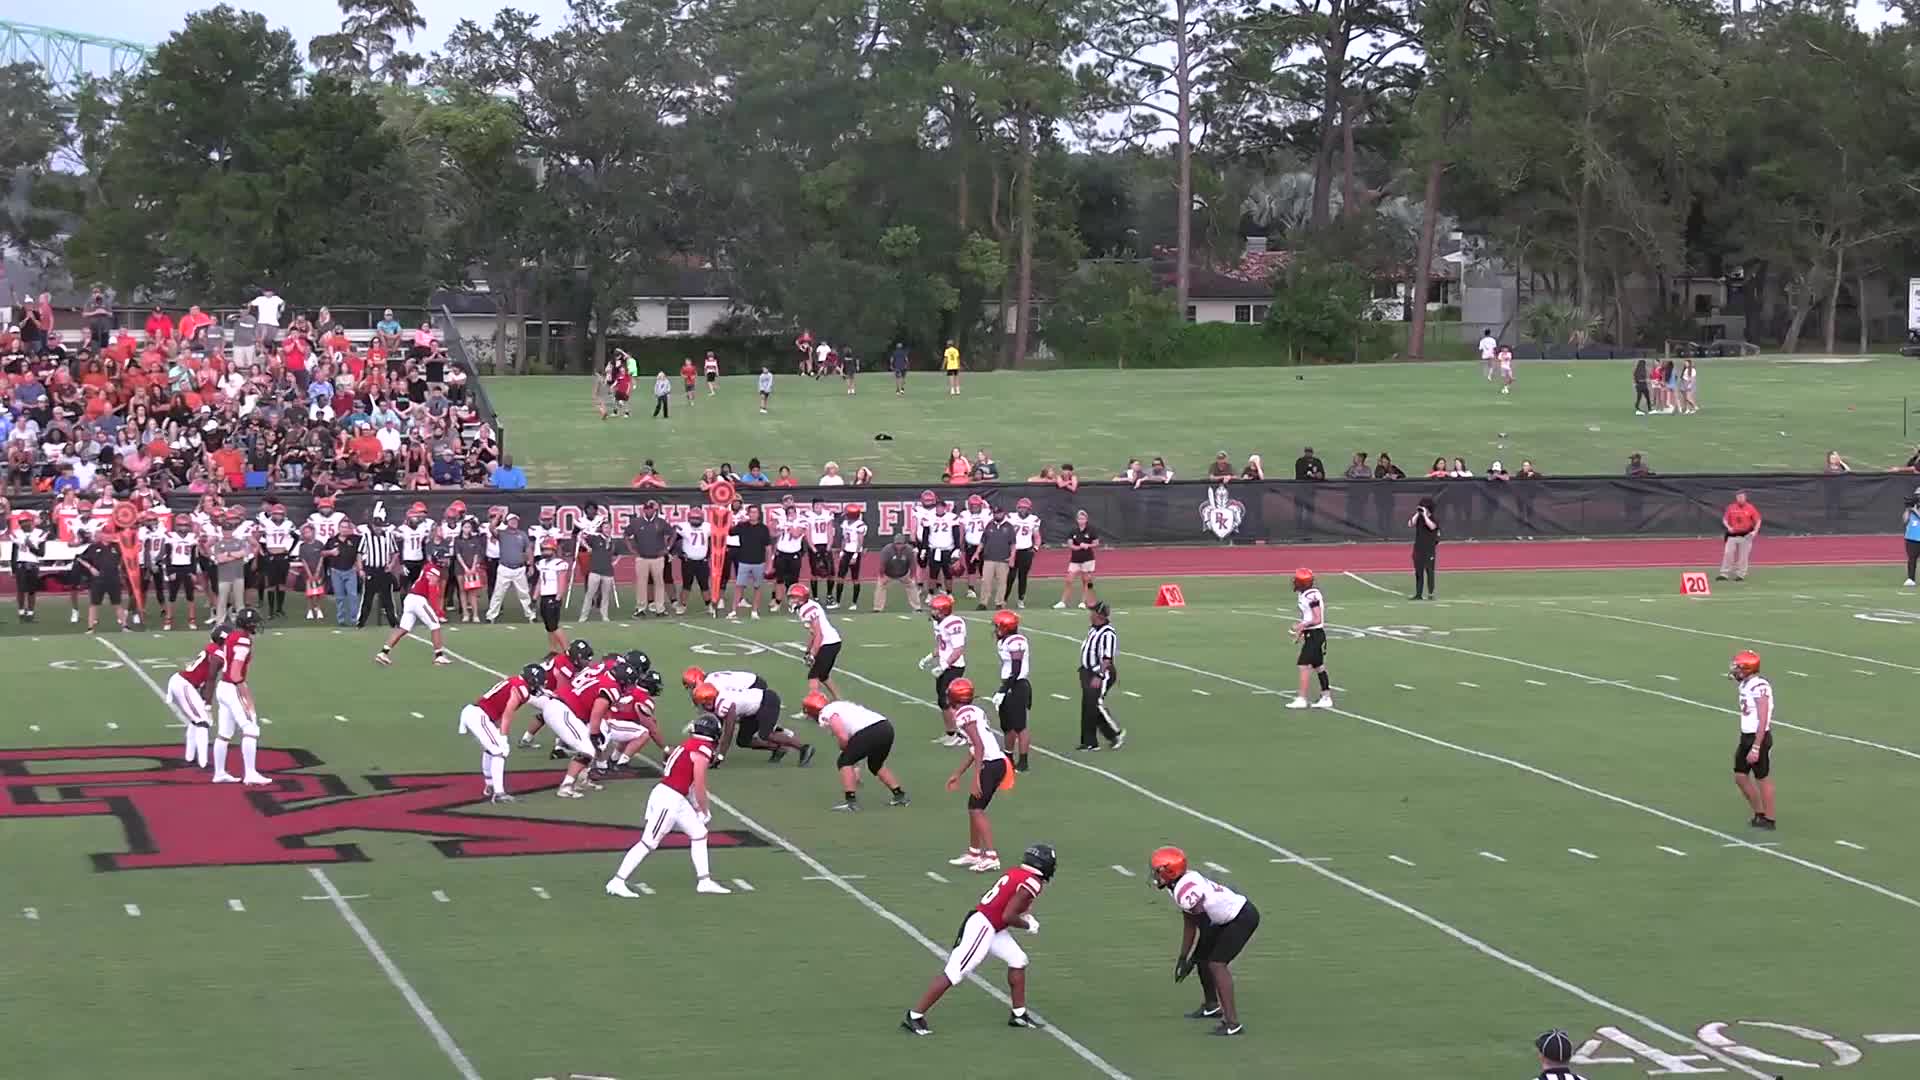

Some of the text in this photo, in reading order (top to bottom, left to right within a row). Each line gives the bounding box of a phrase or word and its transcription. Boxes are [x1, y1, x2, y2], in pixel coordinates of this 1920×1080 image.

[373, 501, 387, 522] 4
[320, 524, 335, 537] 55
[933, 522, 949, 533] 72
[271, 532, 285, 545] 17
[690, 532, 706, 546] 71
[1687, 576, 1706, 593] 20
[1165, 586, 1183, 604] 30
[1570, 1019, 1863, 1074] 40
